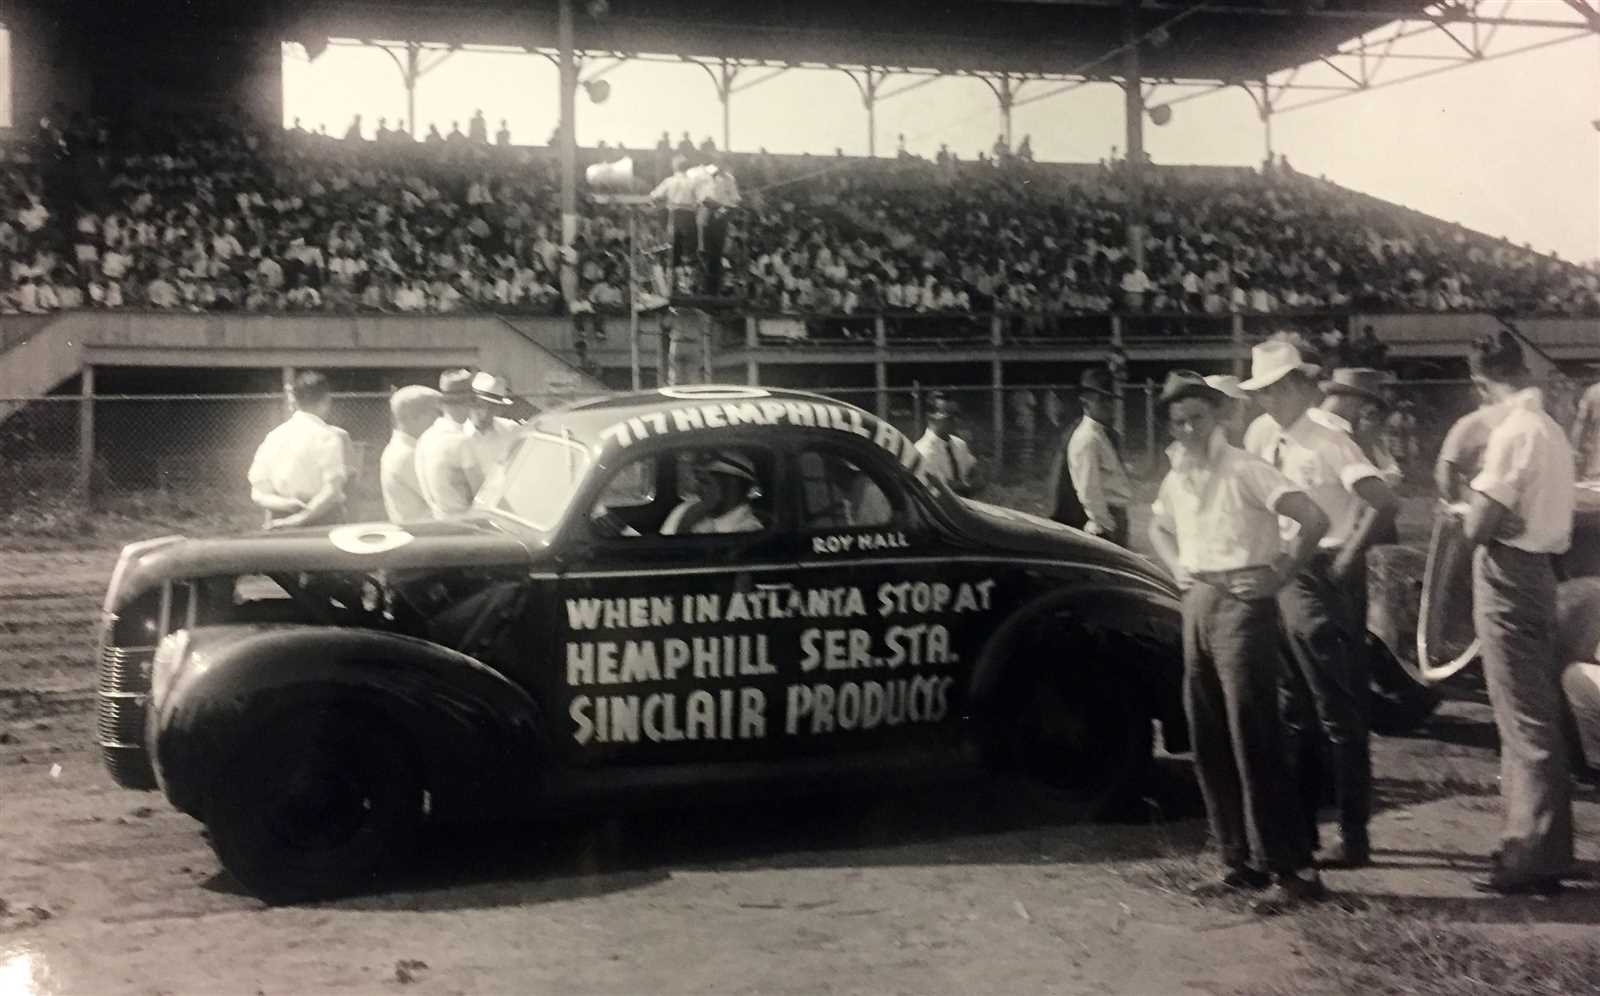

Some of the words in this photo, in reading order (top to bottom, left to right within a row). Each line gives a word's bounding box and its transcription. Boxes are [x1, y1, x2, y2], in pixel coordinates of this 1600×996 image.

[600, 413, 670, 448] 717
[671, 401, 871, 439] HEMPHILL
[811, 535, 853, 554] ROY
[857, 531, 911, 550] HALL
[566, 596, 674, 630] WHEN
[682, 593, 721, 623] IN
[725, 587, 867, 623] ATLANTA
[876, 581, 951, 617] STOP
[953, 578, 996, 613] AT
[566, 634, 778, 686] HEMPHILL
[568, 684, 767, 745] SINCLAIR
[784, 673, 954, 735] PRODUCTS
